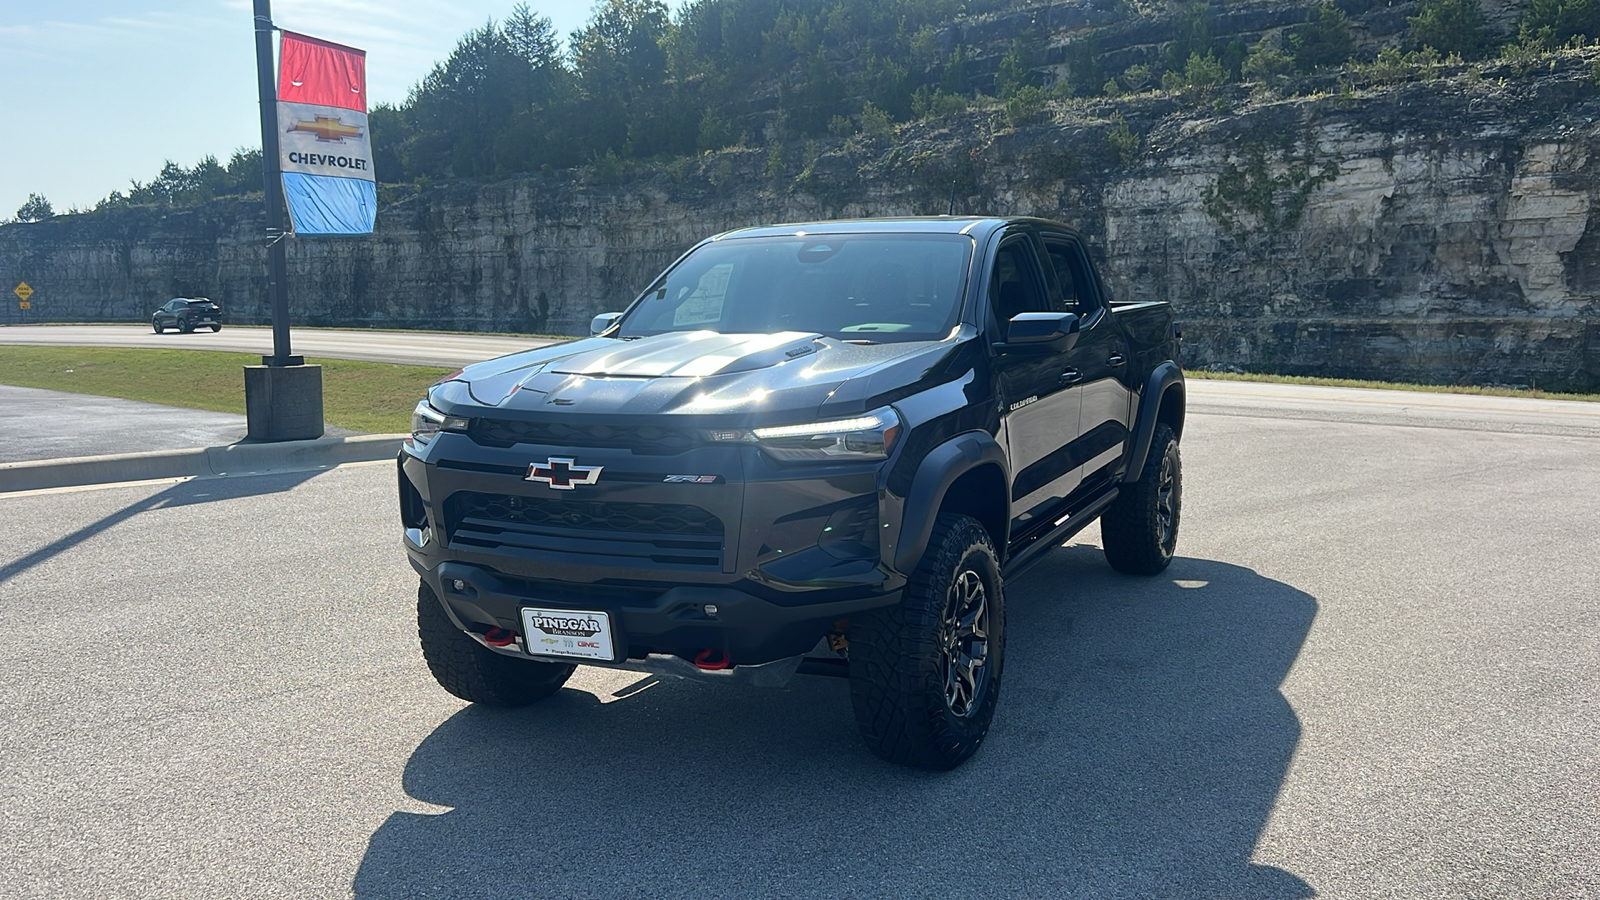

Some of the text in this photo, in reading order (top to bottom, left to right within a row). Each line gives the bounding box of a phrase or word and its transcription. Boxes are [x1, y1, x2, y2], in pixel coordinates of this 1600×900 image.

[288, 152, 367, 171] CHEVROLET
[662, 474, 717, 484] ZR2
[532, 616, 601, 632] PINEGAR
[577, 641, 600, 649] GMC
